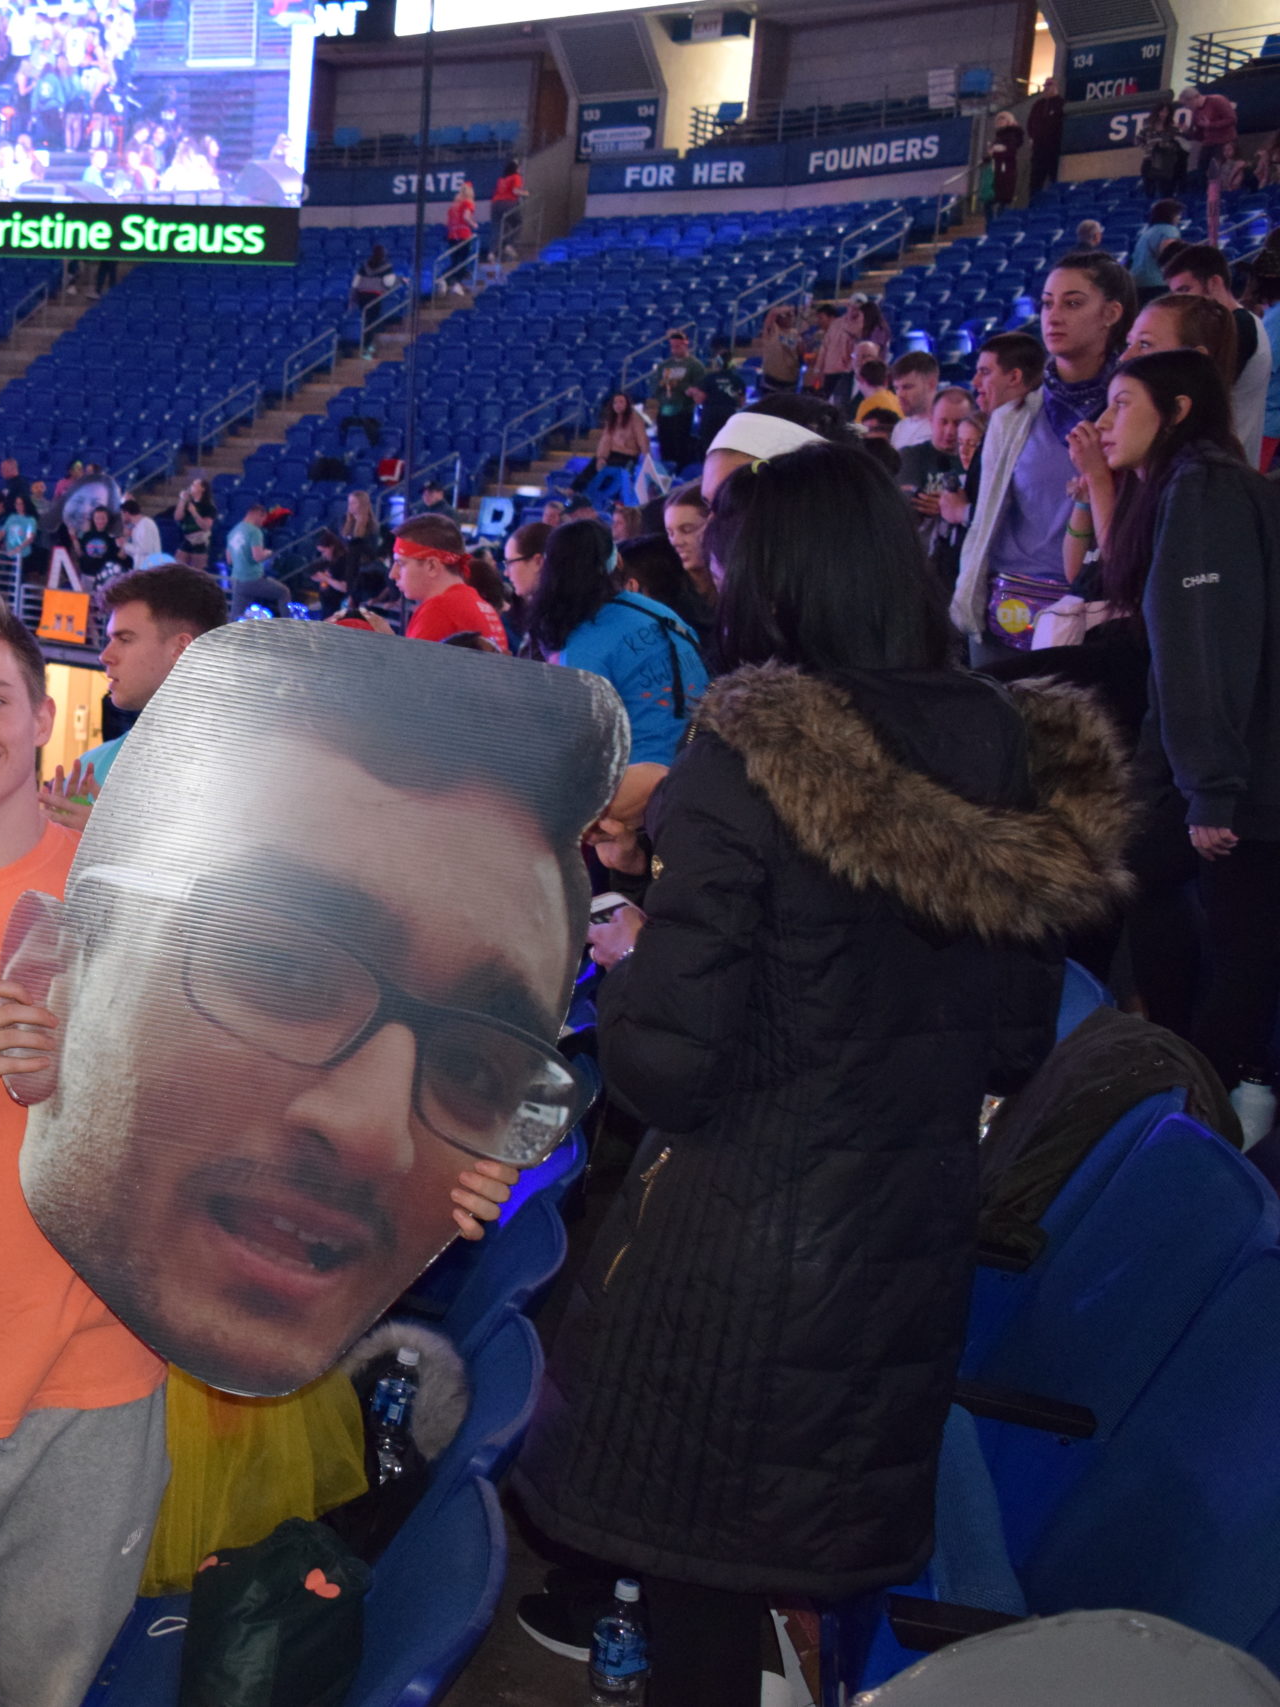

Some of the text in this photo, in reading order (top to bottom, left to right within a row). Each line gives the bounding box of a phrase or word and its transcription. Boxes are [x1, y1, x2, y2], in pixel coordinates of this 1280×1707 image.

[1073, 54, 1094, 68] 134
[1141, 44, 1161, 59] 101
[808, 134, 940, 174] FOUNDERS
[392, 172, 466, 195] STATE
[624, 161, 746, 188] FOR HER
[119, 214, 266, 255] Strauss
[1182, 572, 1220, 588] CHAIR
